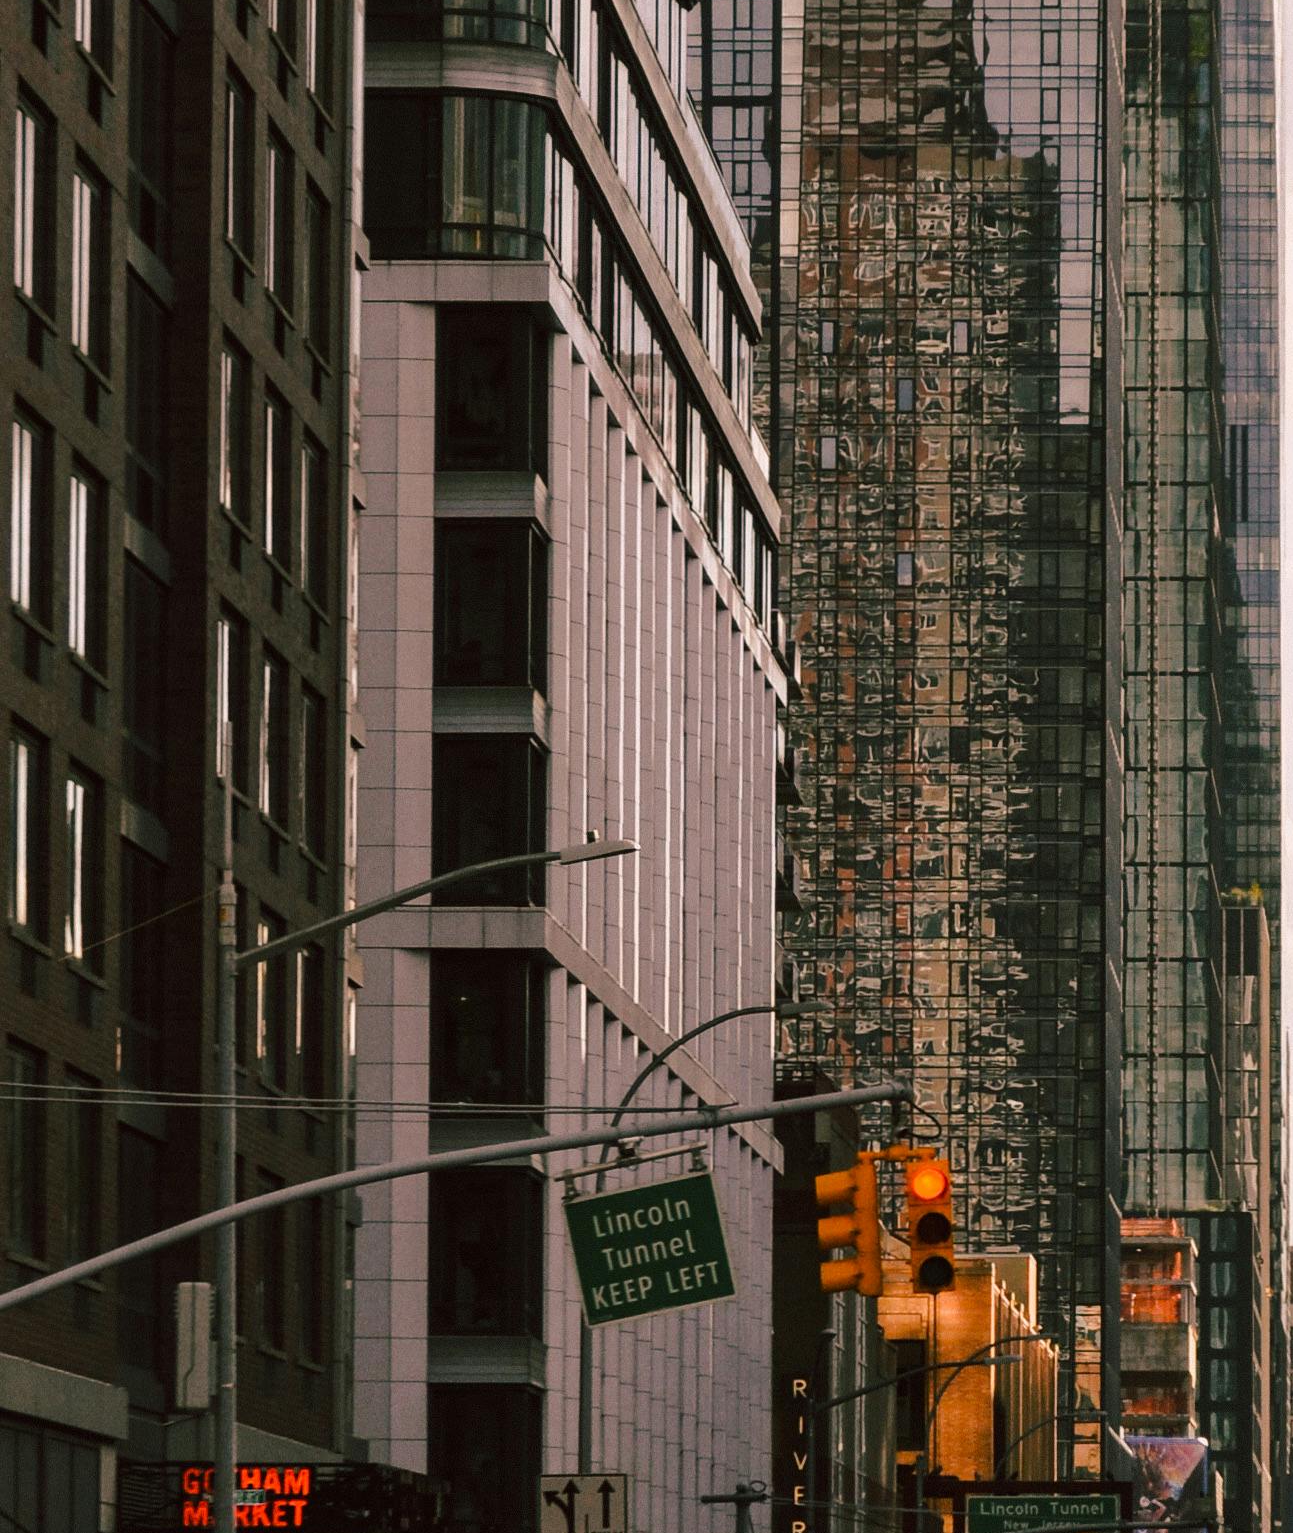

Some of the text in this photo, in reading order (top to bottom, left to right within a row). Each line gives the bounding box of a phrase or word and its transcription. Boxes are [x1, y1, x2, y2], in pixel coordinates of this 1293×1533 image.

[592, 1197, 692, 1238] Lincoln
[601, 1229, 697, 1271] Tunnel
[592, 1261, 719, 1310] KEEP LEFT
[182, 1499, 308, 1528] MRKET
[979, 1502, 1104, 1516] Lincoln Tunnel
